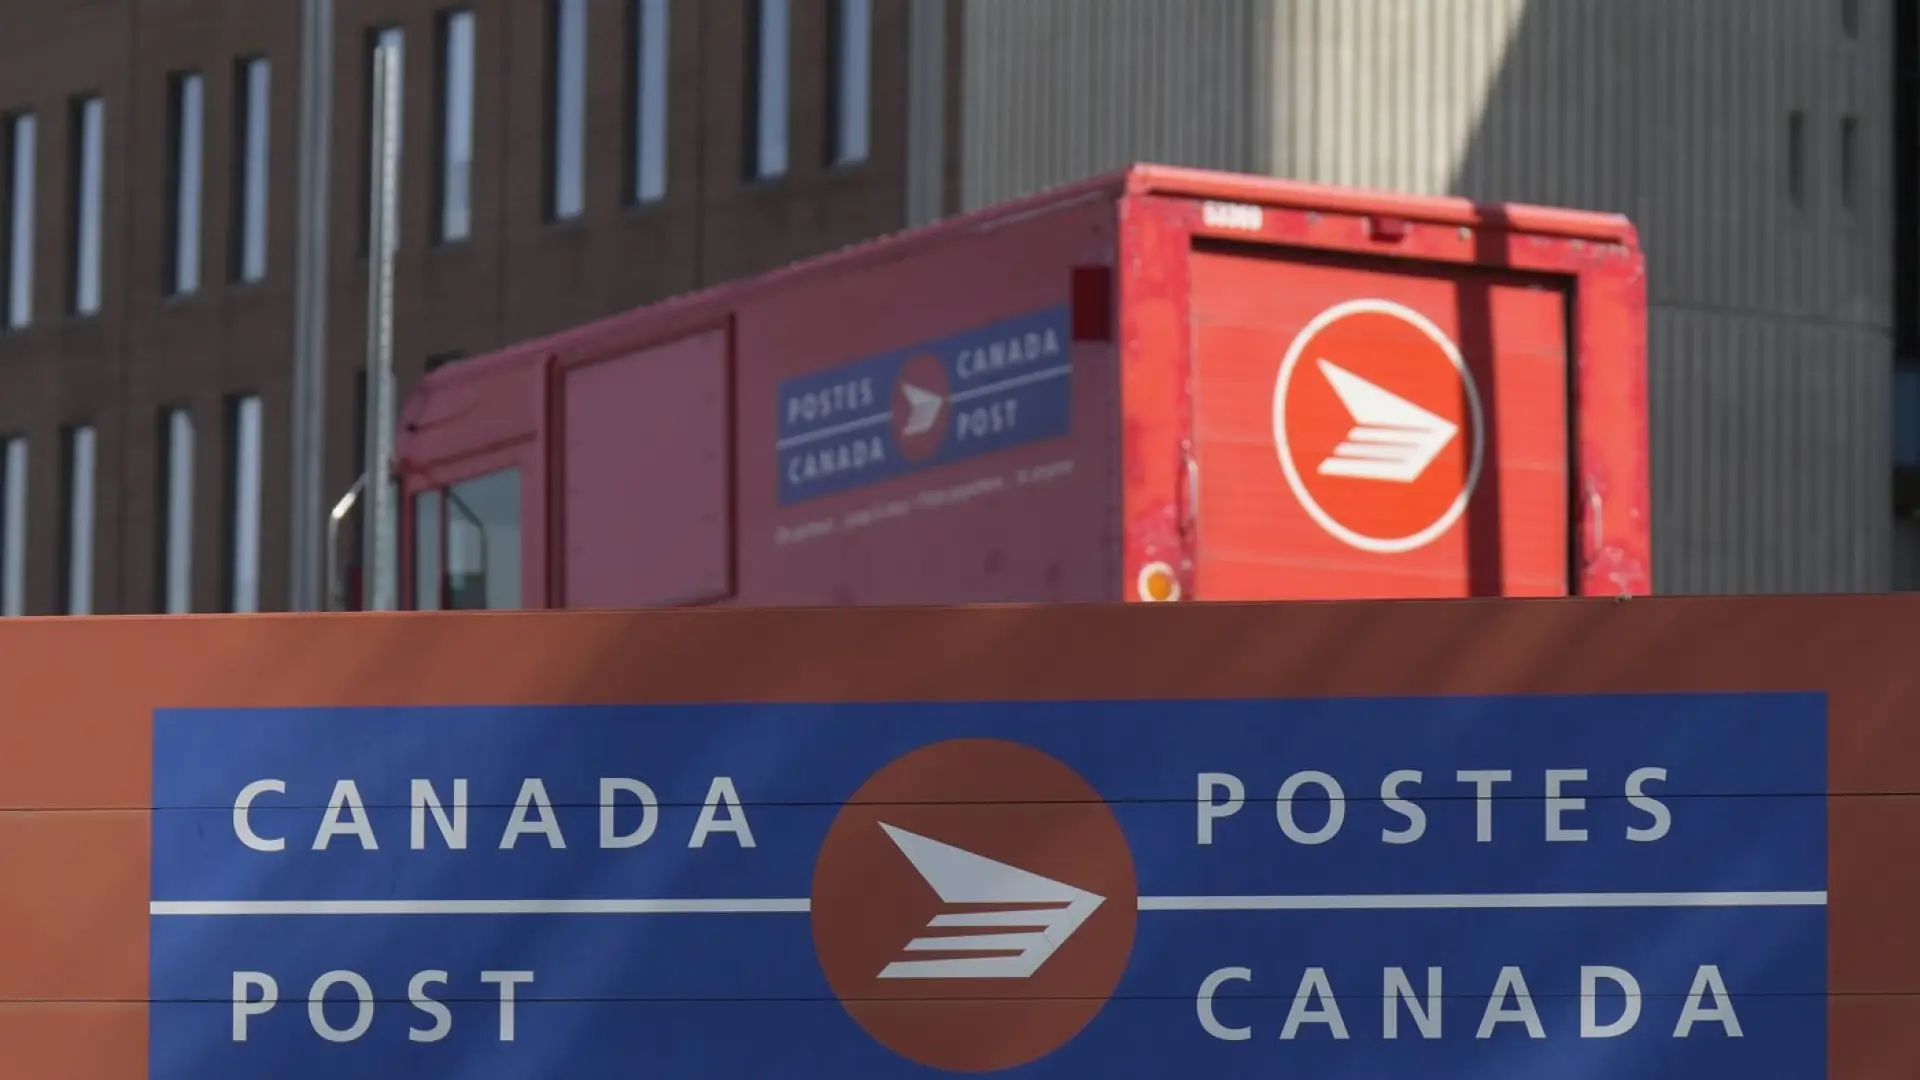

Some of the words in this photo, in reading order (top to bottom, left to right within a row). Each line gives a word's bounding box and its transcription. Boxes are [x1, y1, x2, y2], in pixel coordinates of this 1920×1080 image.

[956, 328, 1059, 379] CANADA
[787, 377, 874, 423] POSTES
[957, 400, 1018, 440] POST
[788, 436, 885, 485] CANADA
[233, 777, 756, 852] CANADA
[1198, 767, 1670, 844] POSTES
[233, 970, 533, 1042] POST
[1197, 965, 1743, 1040] CANADA
